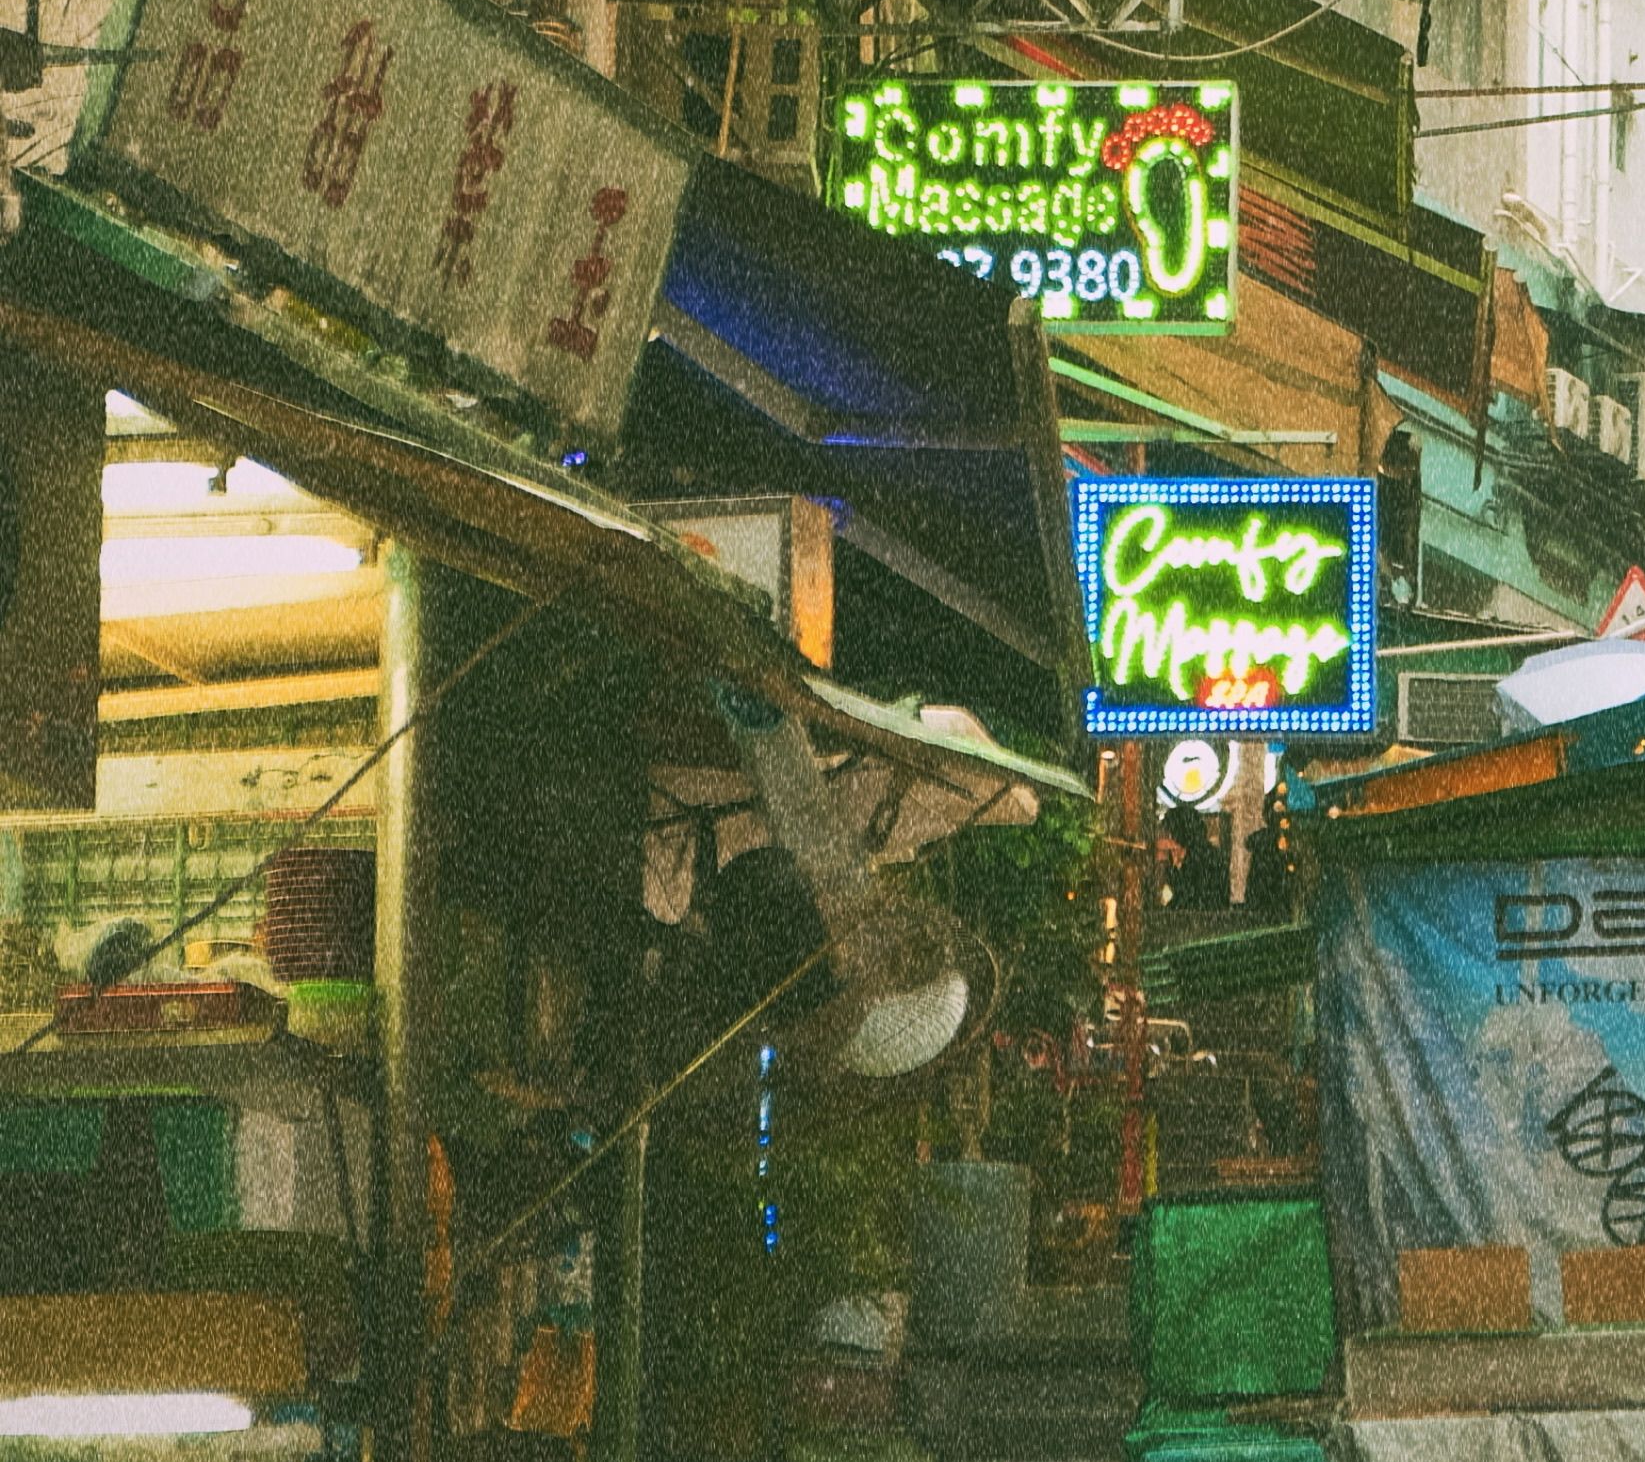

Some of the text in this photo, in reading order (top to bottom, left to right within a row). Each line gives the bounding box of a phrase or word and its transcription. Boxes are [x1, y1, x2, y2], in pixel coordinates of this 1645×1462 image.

[874, 107, 1105, 177] Comfy
[868, 160, 1118, 247] Massage
[1010, 249, 1141, 302] 9380
[1103, 505, 1343, 602] Comfy
